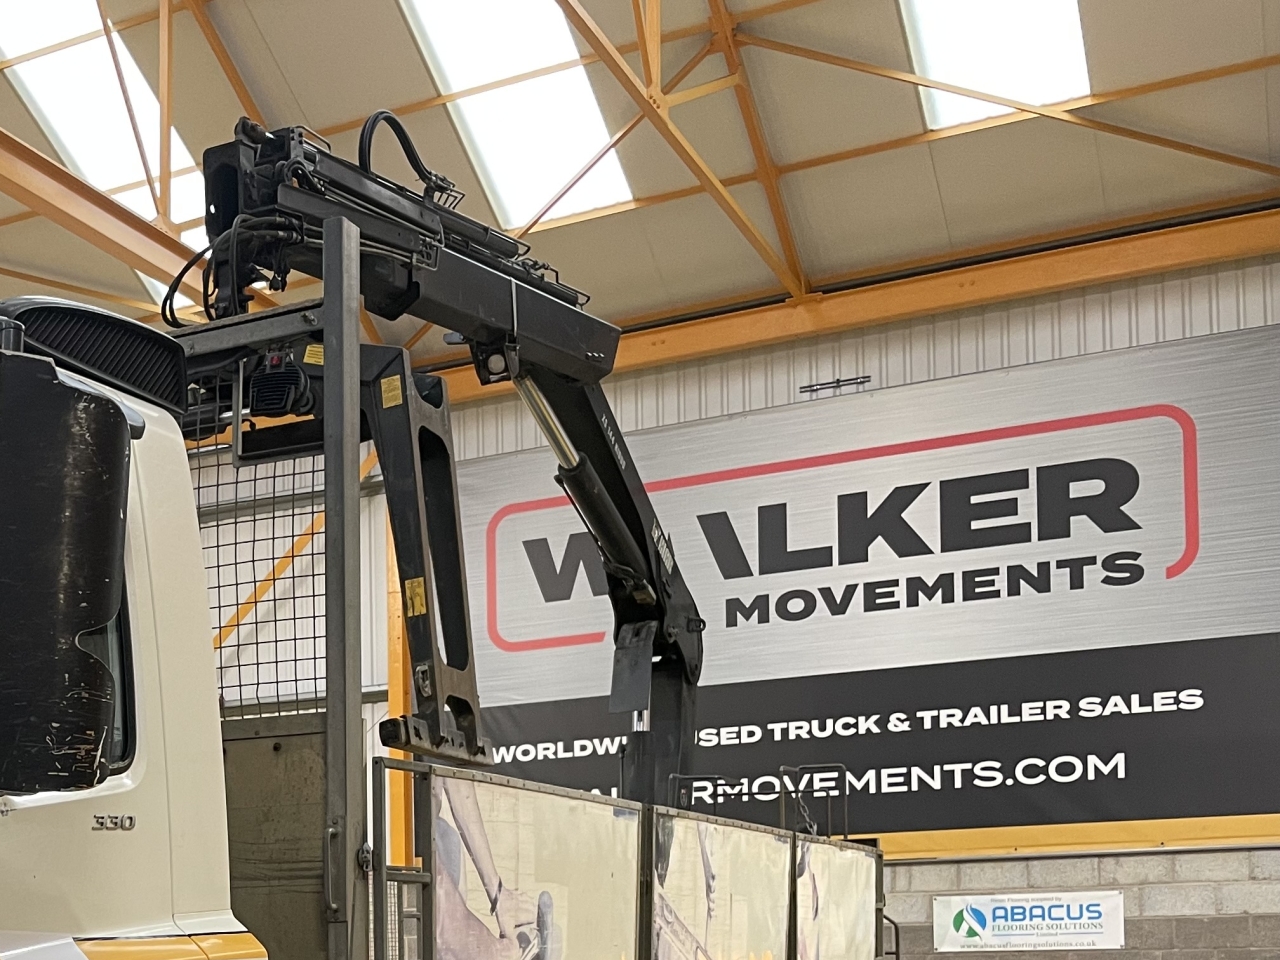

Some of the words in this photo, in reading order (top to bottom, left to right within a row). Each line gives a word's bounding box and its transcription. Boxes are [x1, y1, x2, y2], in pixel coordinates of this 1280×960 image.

[725, 550, 1145, 628] MOVEMENTS
[492, 736, 628, 764] WORLDW
[694, 724, 762, 747] SED
[767, 714, 881, 741] TRUCK
[887, 712, 911, 732] &
[916, 699, 1071, 730] TRAILER
[1078, 688, 1204, 718] SALES
[91, 814, 136, 831] 330
[992, 903, 1103, 923] ABACUS
[992, 923, 1044, 932] FLOORING
[1046, 921, 1103, 931] SOLUTIONS
